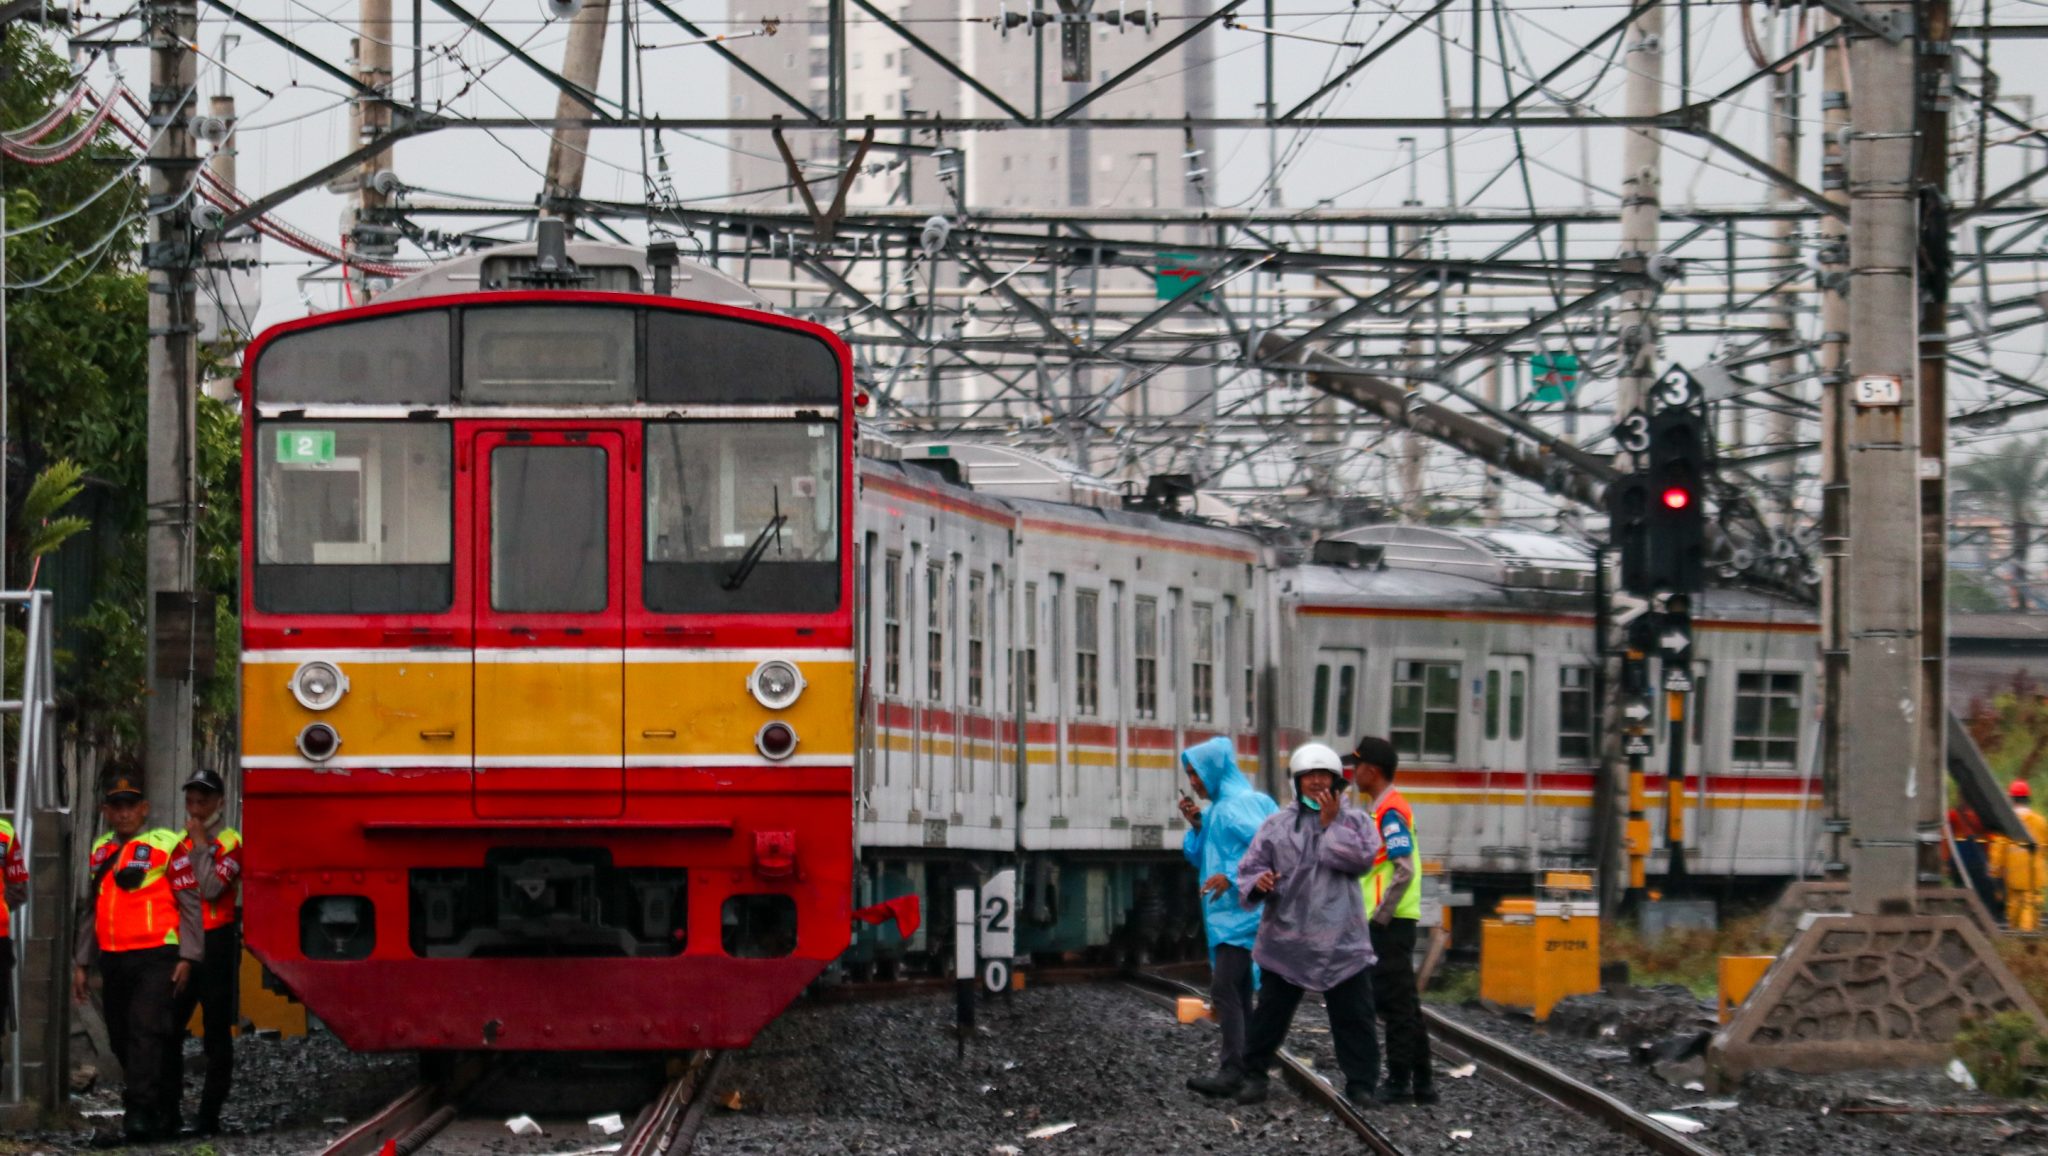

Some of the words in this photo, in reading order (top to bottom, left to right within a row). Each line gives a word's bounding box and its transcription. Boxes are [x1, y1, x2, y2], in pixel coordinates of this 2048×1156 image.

[1663, 371, 1689, 405] 3
[1864, 382, 1893, 399] 5-1
[297, 436, 314, 456] 2
[1624, 415, 1650, 452] 3
[985, 896, 1010, 933] 2
[985, 960, 1008, 992] 0
